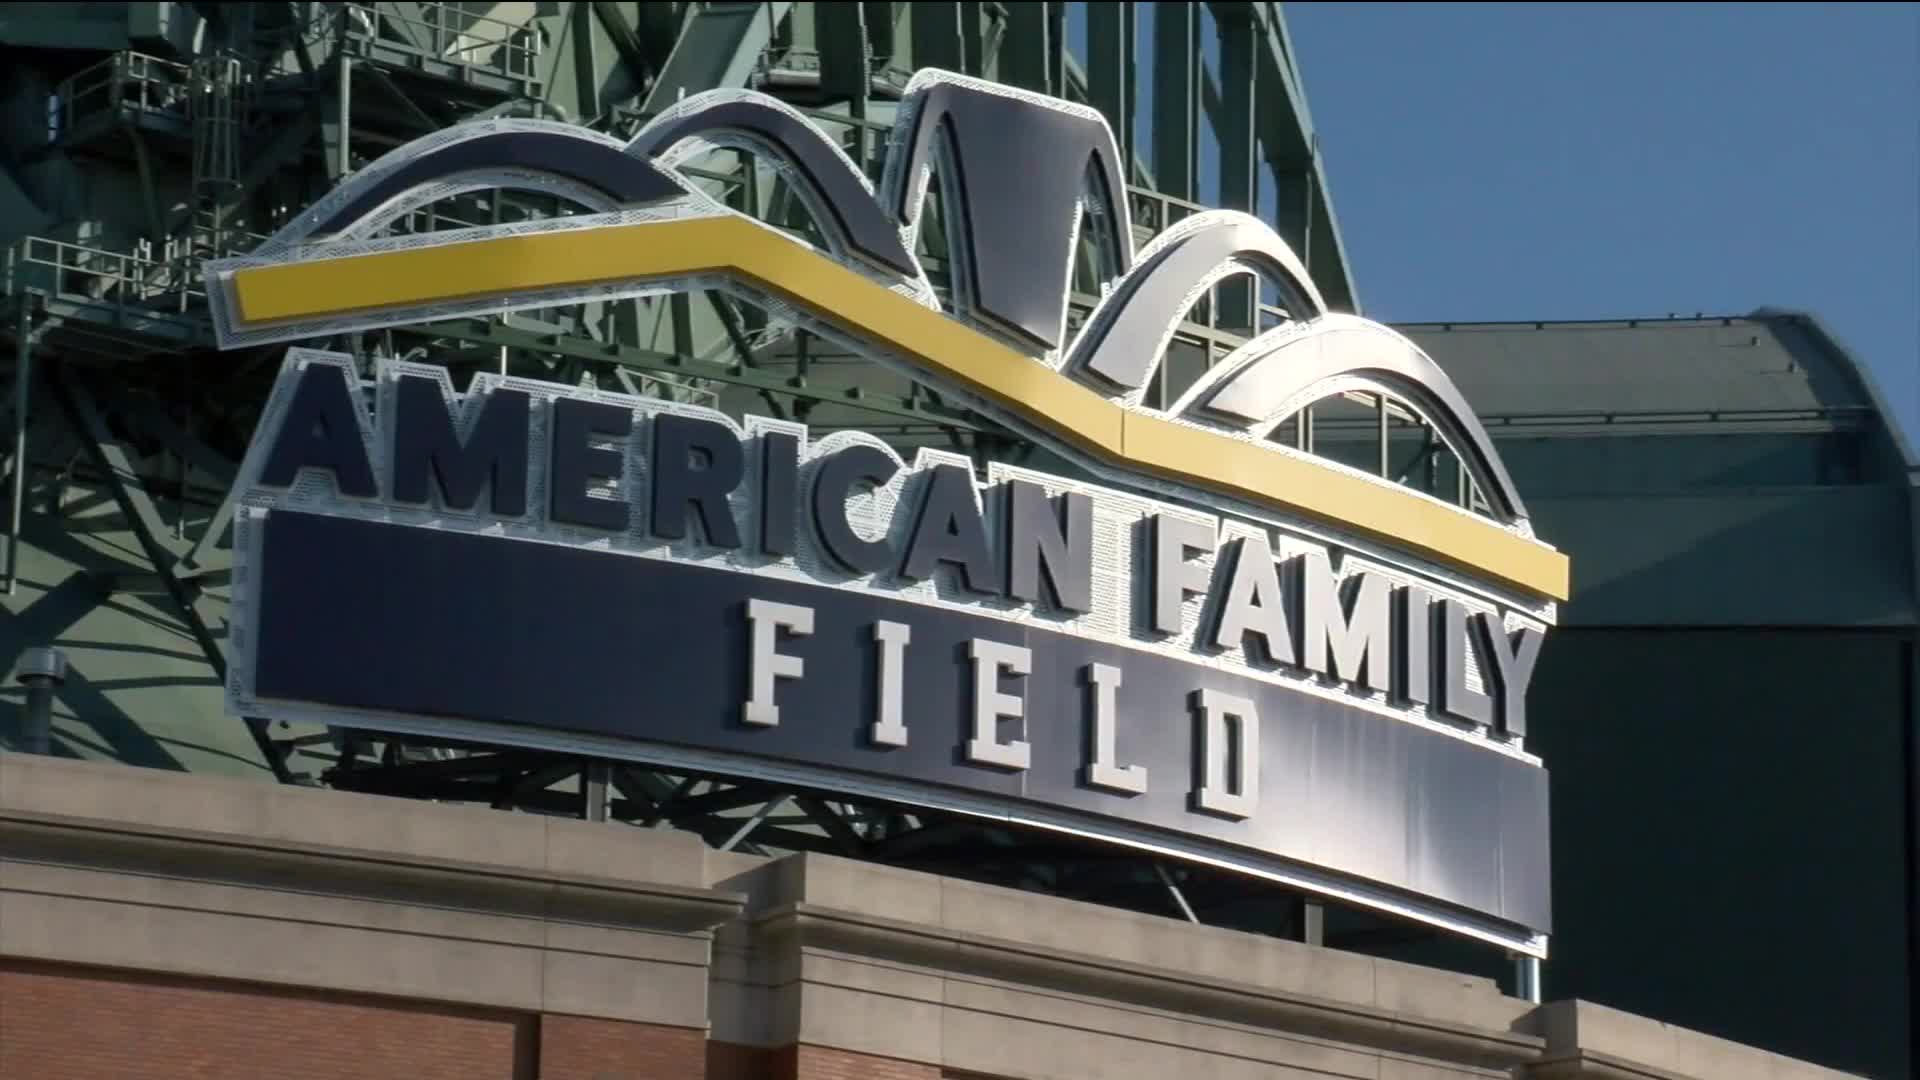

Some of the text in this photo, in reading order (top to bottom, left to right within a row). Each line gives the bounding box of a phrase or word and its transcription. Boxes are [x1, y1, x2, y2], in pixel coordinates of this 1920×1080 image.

[260, 361, 1547, 739] AMERICAN FAMILY
[743, 597, 1261, 819] FIELD
